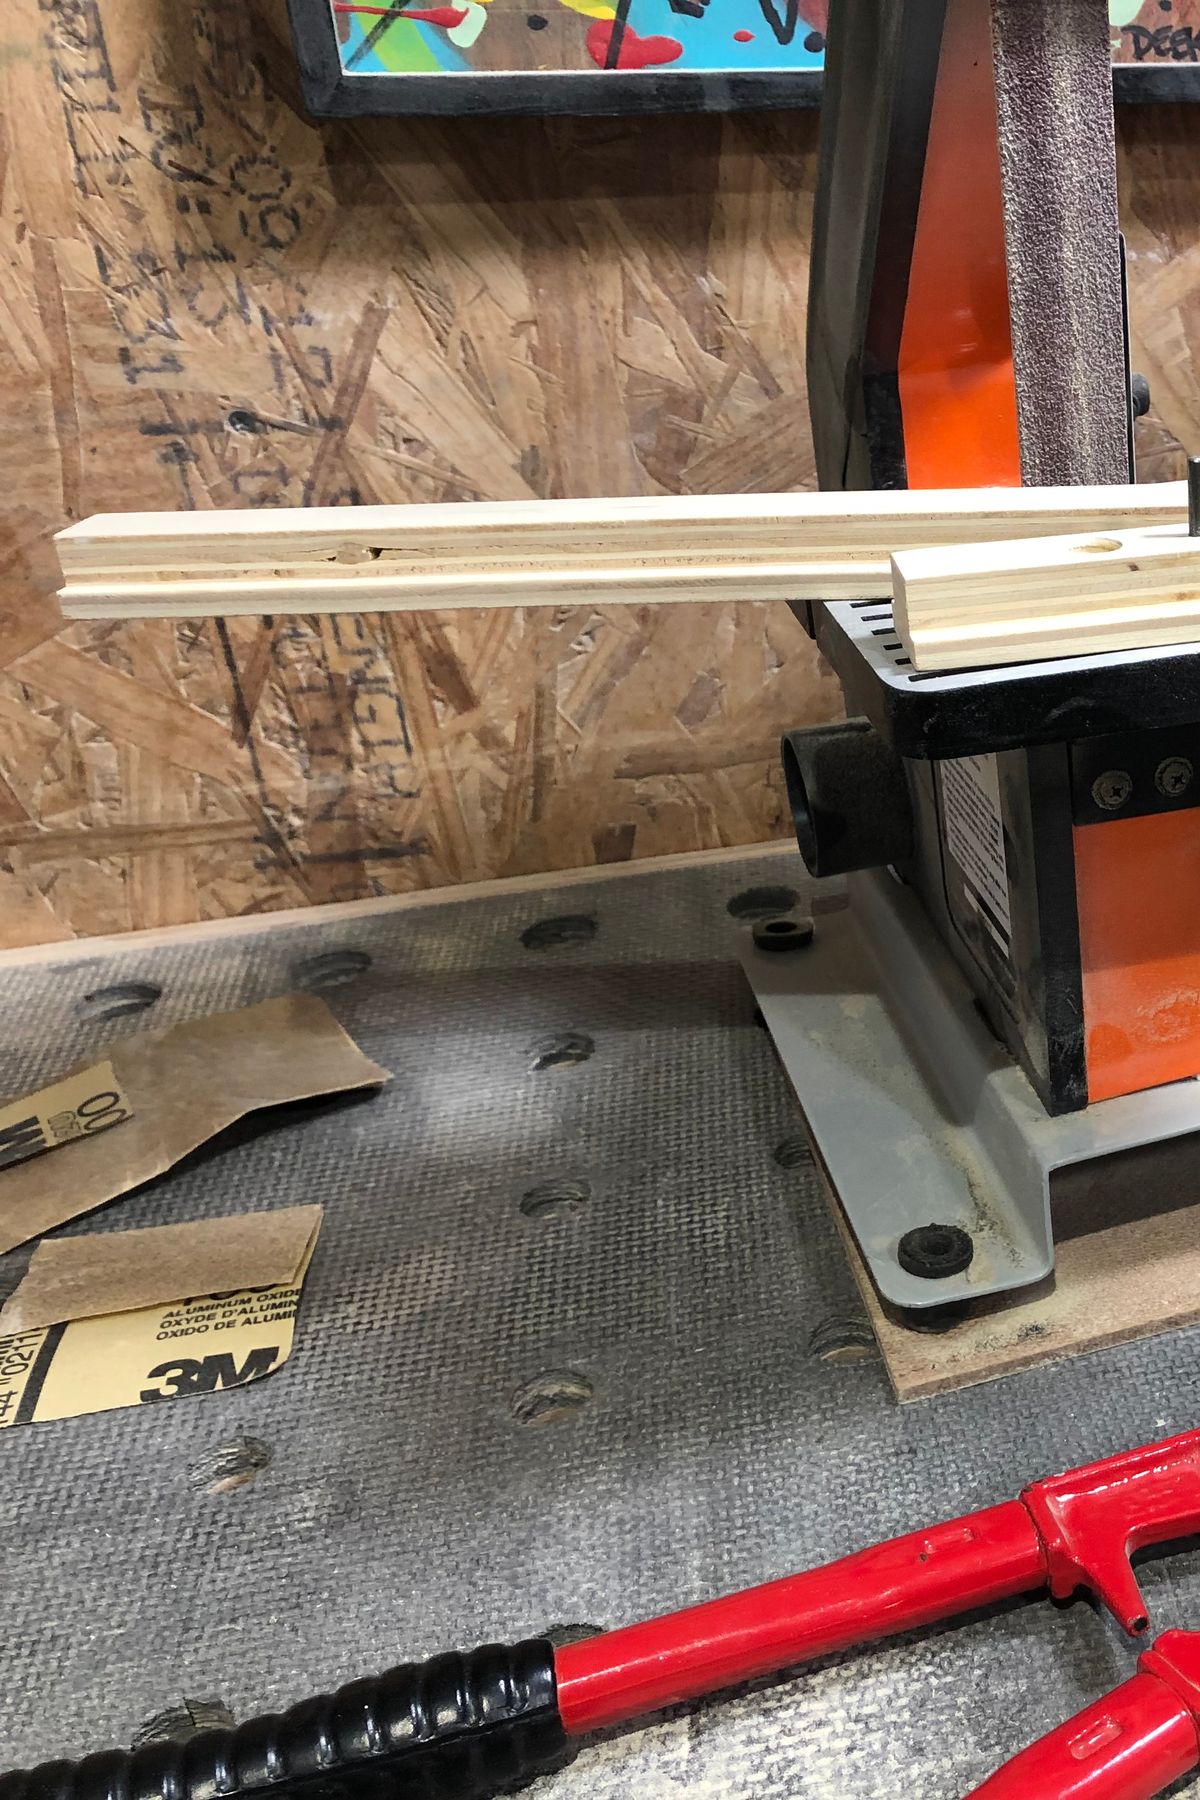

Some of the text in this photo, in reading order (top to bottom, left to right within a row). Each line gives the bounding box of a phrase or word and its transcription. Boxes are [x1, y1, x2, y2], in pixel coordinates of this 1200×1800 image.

[162, 1297, 252, 1319] ALUMINUM
[156, 1325, 209, 1340] OXIDO
[214, 1319, 236, 1330] DE
[160, 1312, 217, 1329] OXYDE
[139, 1346, 279, 1402] 3M
